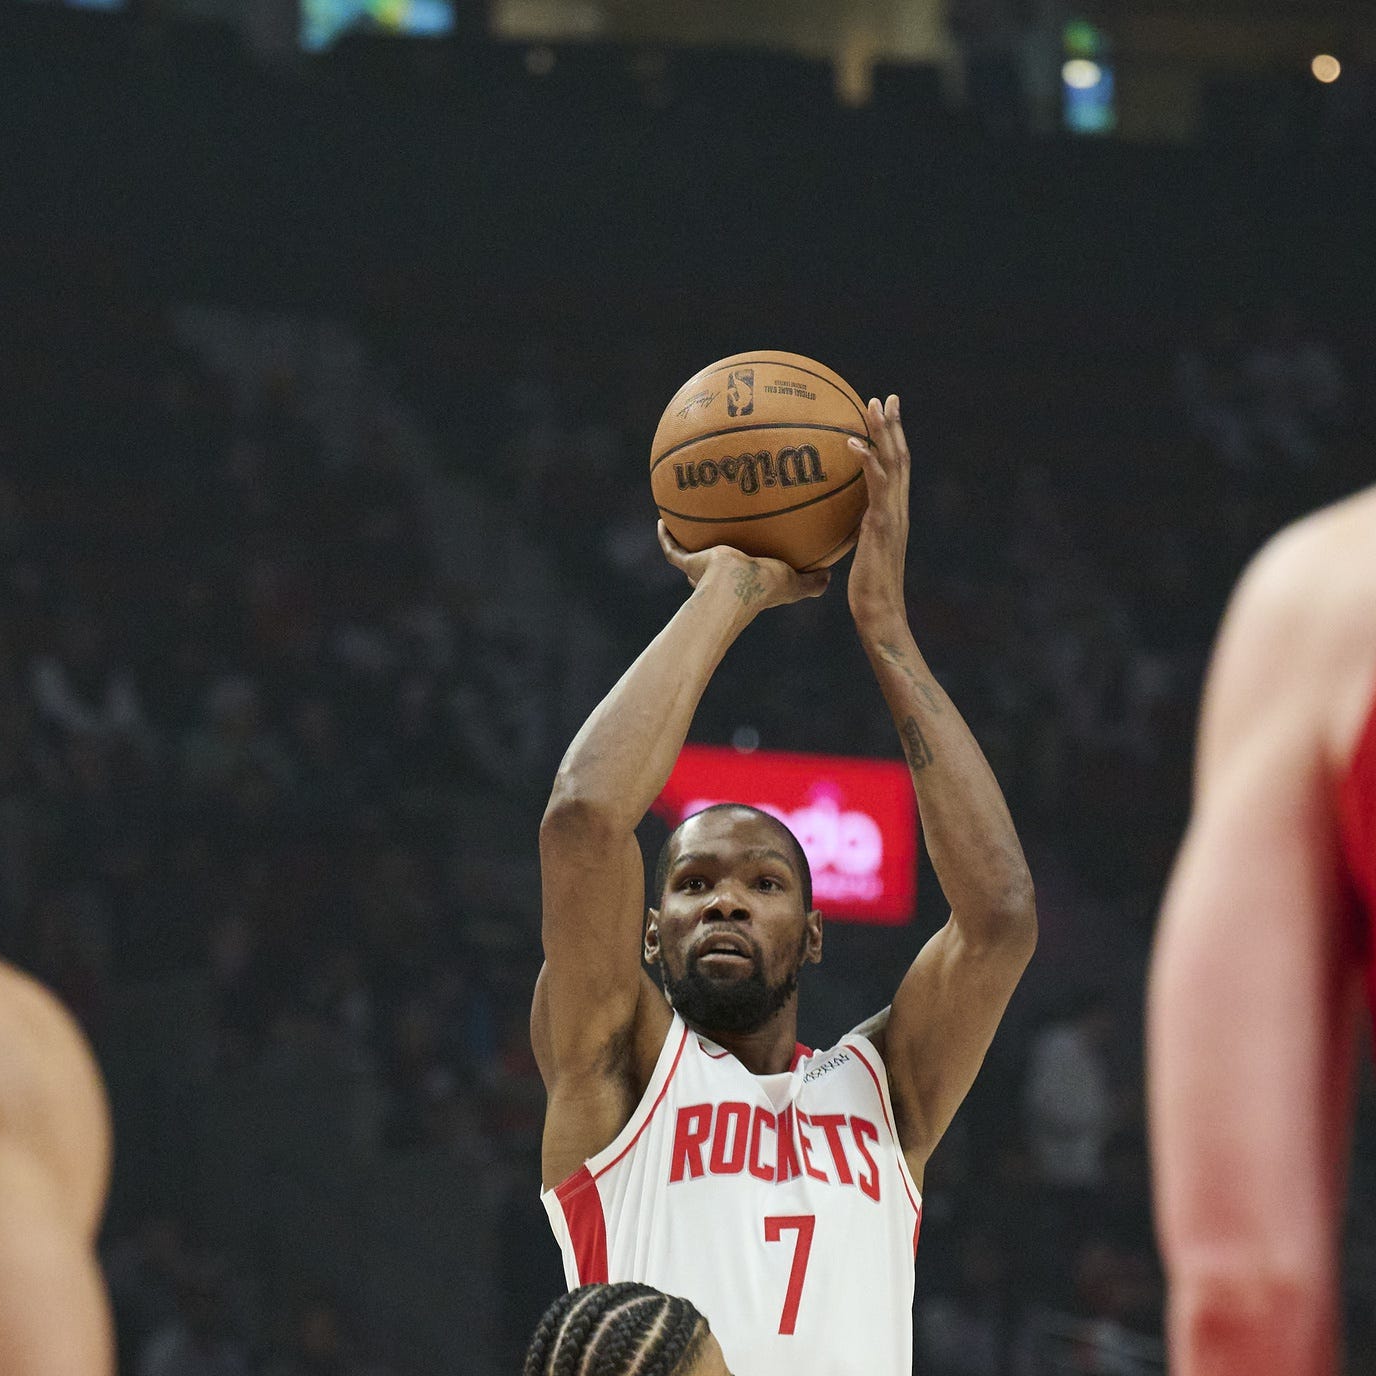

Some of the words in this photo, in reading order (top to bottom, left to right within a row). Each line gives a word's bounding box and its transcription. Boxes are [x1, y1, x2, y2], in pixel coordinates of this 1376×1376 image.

[673, 443, 827, 496] Wilson
[667, 1101, 882, 1205] ROCKETS
[764, 1214, 816, 1336] 7
